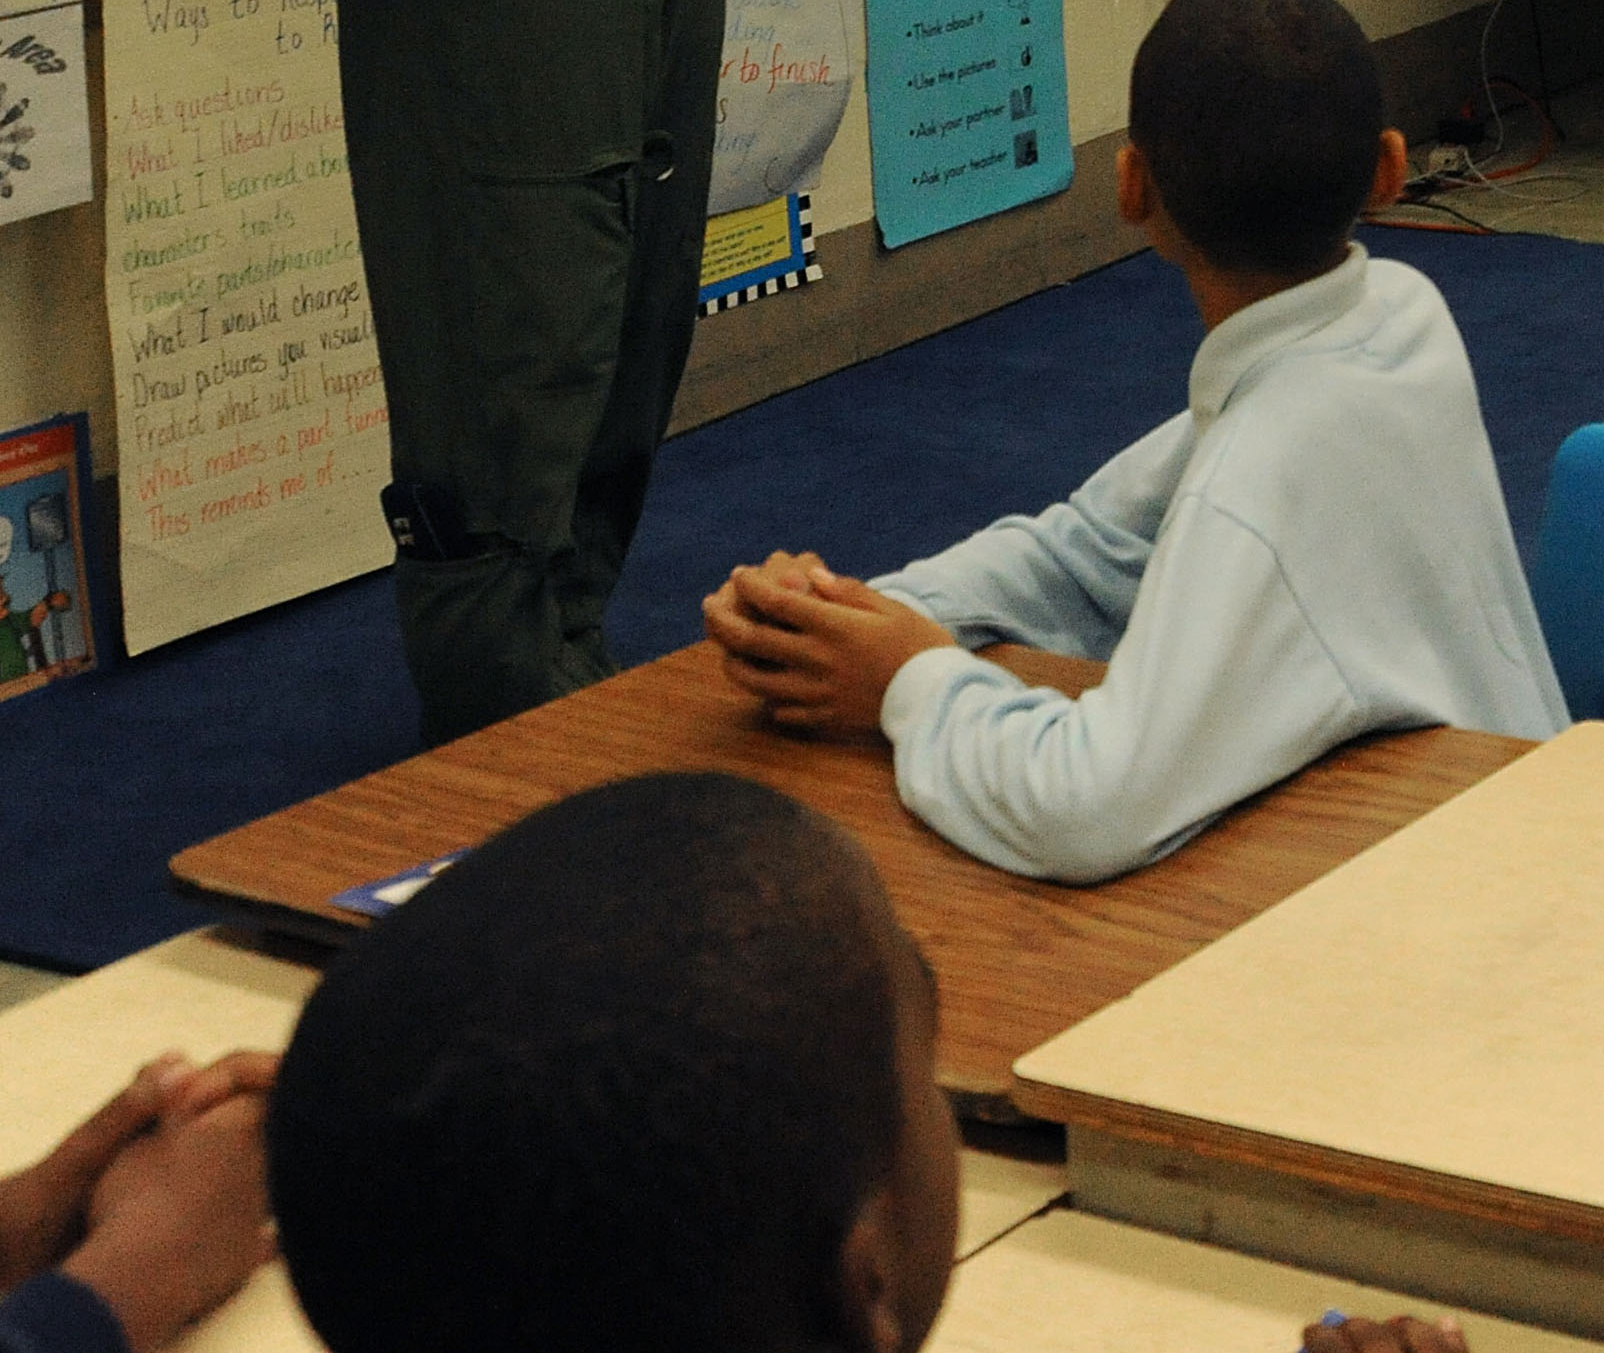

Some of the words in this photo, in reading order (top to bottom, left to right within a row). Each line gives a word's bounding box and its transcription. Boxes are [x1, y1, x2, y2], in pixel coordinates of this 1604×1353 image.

[275, 18, 302, 55] to
[912, 19, 942, 41] Think
[946, 15, 975, 32] about
[740, 47, 760, 84] to
[768, 43, 832, 95] finish
[913, 73, 935, 90] Use
[938, 68, 955, 83] the
[957, 59, 996, 84] pictures
[175, 76, 285, 133] questions
[916, 120, 937, 138] Ask
[939, 117, 963, 140] your
[965, 105, 1006, 130] partner
[122, 179, 185, 224] What
[194, 172, 209, 209] I
[221, 151, 303, 200] learned
[919, 167, 940, 186] Ask
[943, 164, 967, 184] your
[970, 151, 1008, 170] teacher
[128, 315, 186, 363] What
[194, 307, 209, 344] I
[222, 289, 281, 335] would
[292, 281, 360, 319] change
[132, 373, 186, 408] Draw
[195, 349, 267, 402] pictures
[278, 341, 307, 381] you
[217, 385, 260, 430] what
[270, 370, 308, 412] will
[137, 447, 192, 501] What
[146, 504, 190, 540] This
[201, 477, 271, 524] reminds
[281, 473, 306, 499] me
